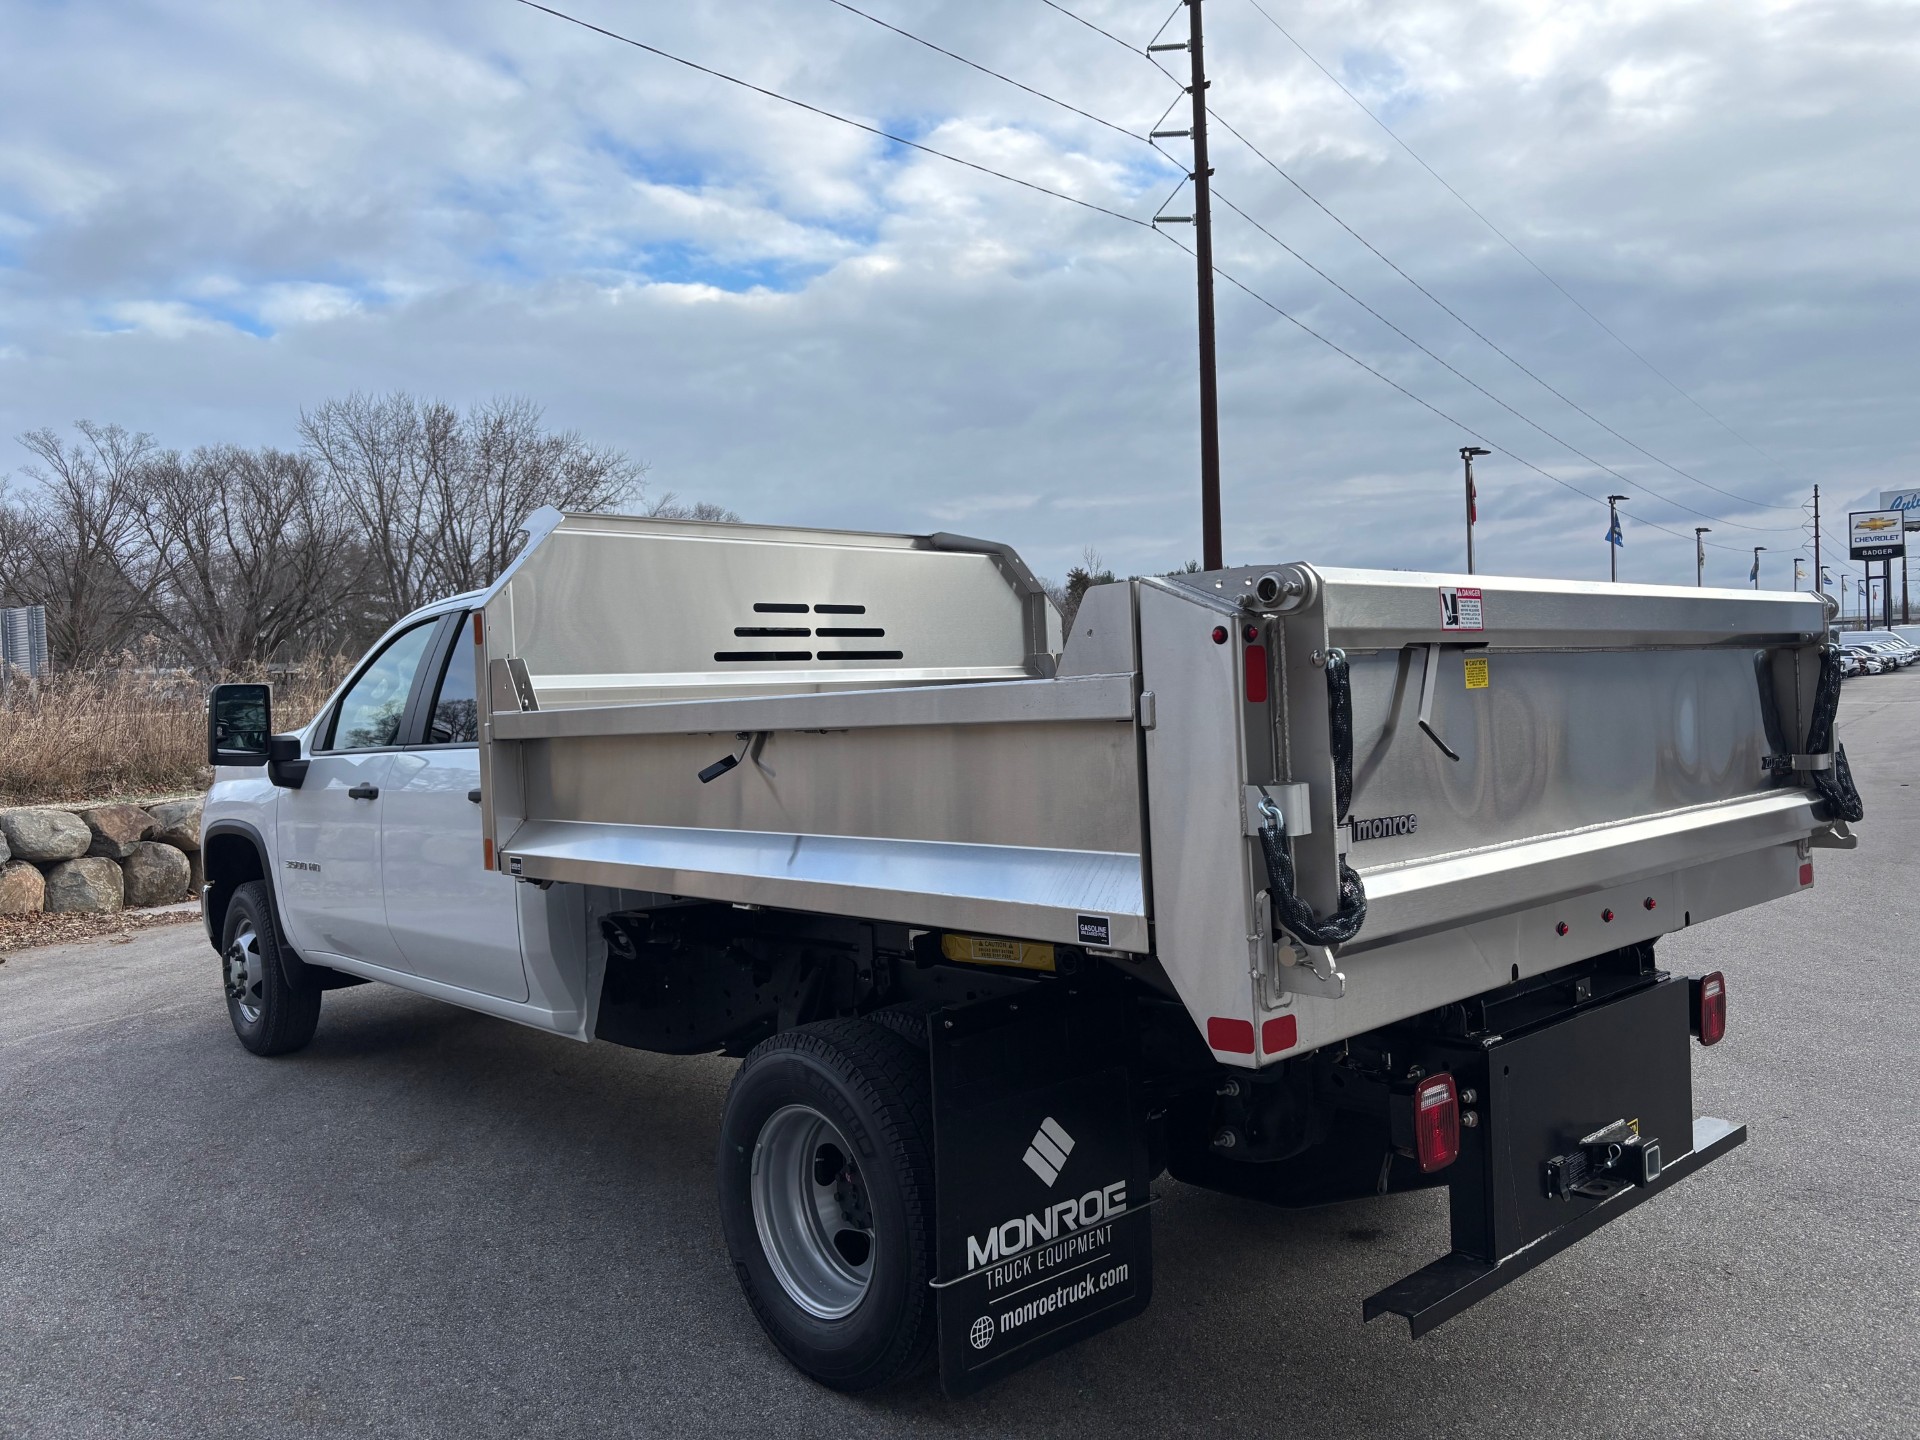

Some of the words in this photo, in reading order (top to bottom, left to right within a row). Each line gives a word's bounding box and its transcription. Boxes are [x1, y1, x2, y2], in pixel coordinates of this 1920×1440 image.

[1854, 534, 1900, 543] CHEVROLET
[1862, 548, 1893, 556] BADGER
[1461, 589, 1480, 597] DANGER
[1355, 814, 1418, 841] monroe
[1080, 924, 1107, 934] GASOLINE
[967, 1180, 1127, 1271] MONROE
[986, 1254, 1032, 1290] TRUCK
[1038, 1225, 1113, 1270] EQUIPMENT
[1001, 1264, 1128, 1333] monroetruck.com
